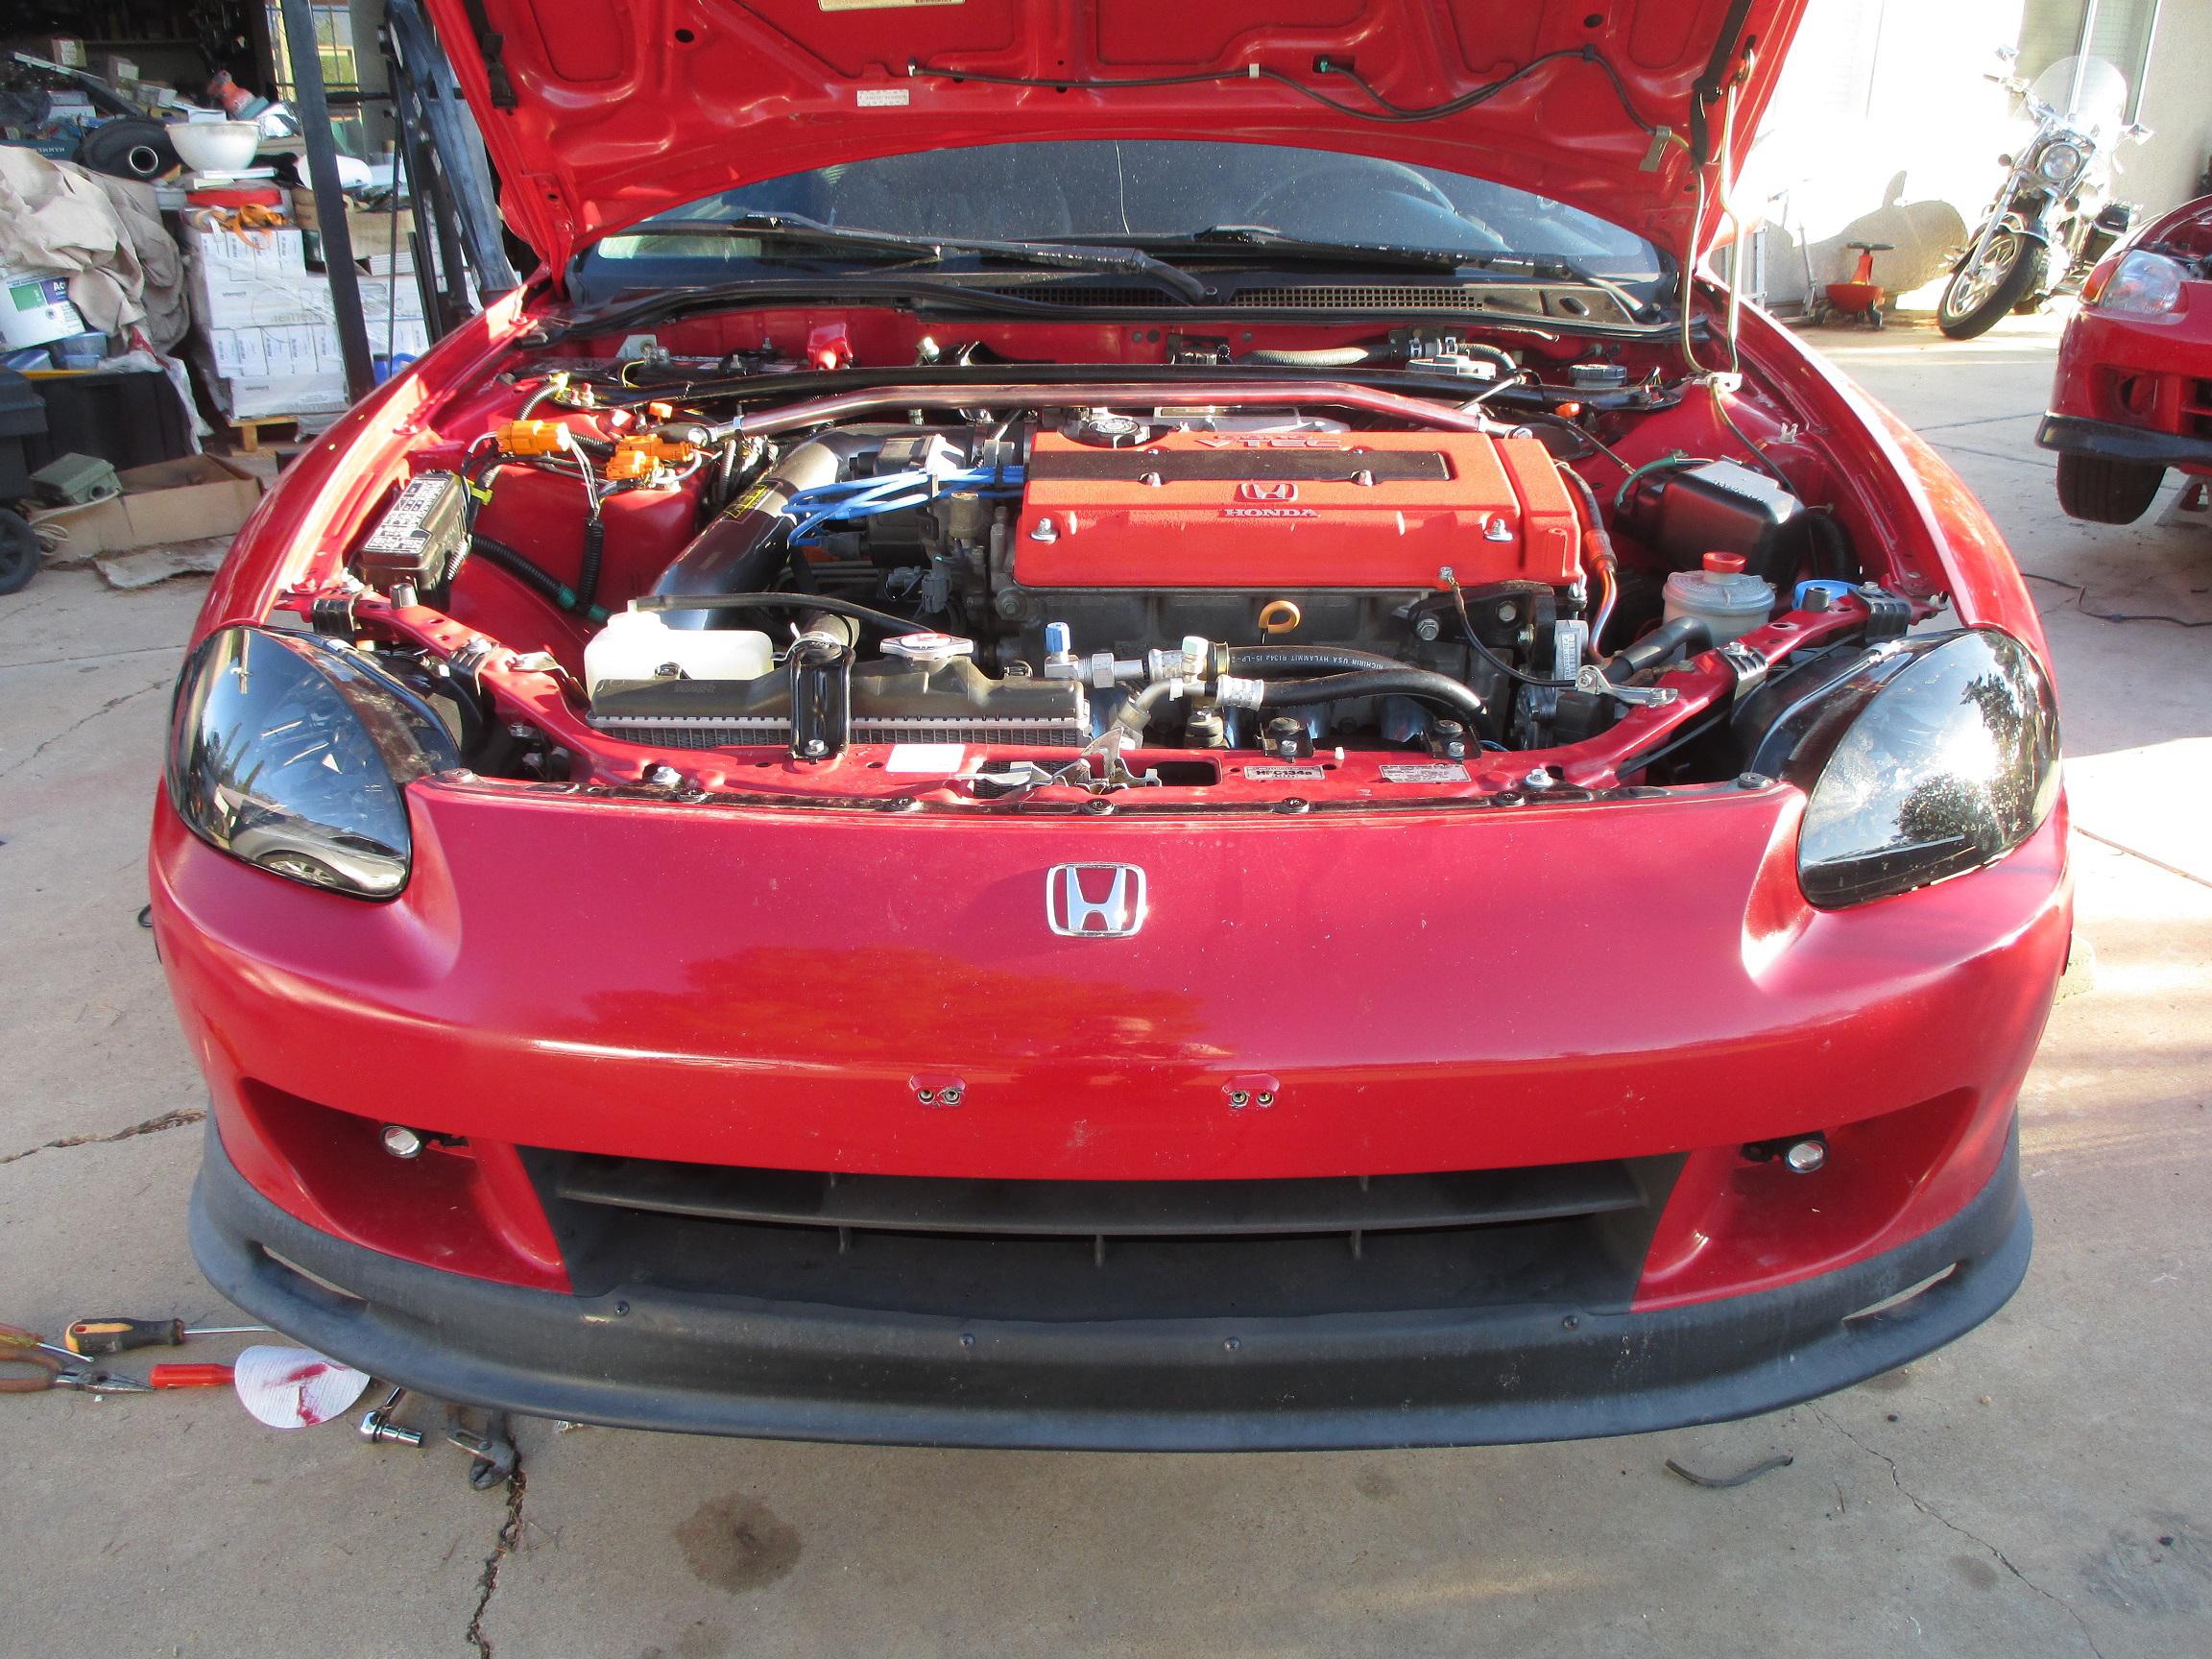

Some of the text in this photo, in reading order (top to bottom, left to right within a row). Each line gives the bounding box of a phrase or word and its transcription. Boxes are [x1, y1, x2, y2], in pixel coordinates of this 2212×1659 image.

[1194, 439, 1343, 448] VTEC
[1223, 508, 1320, 518] HONDA
[1351, 659, 1383, 670] NICHIRIN
